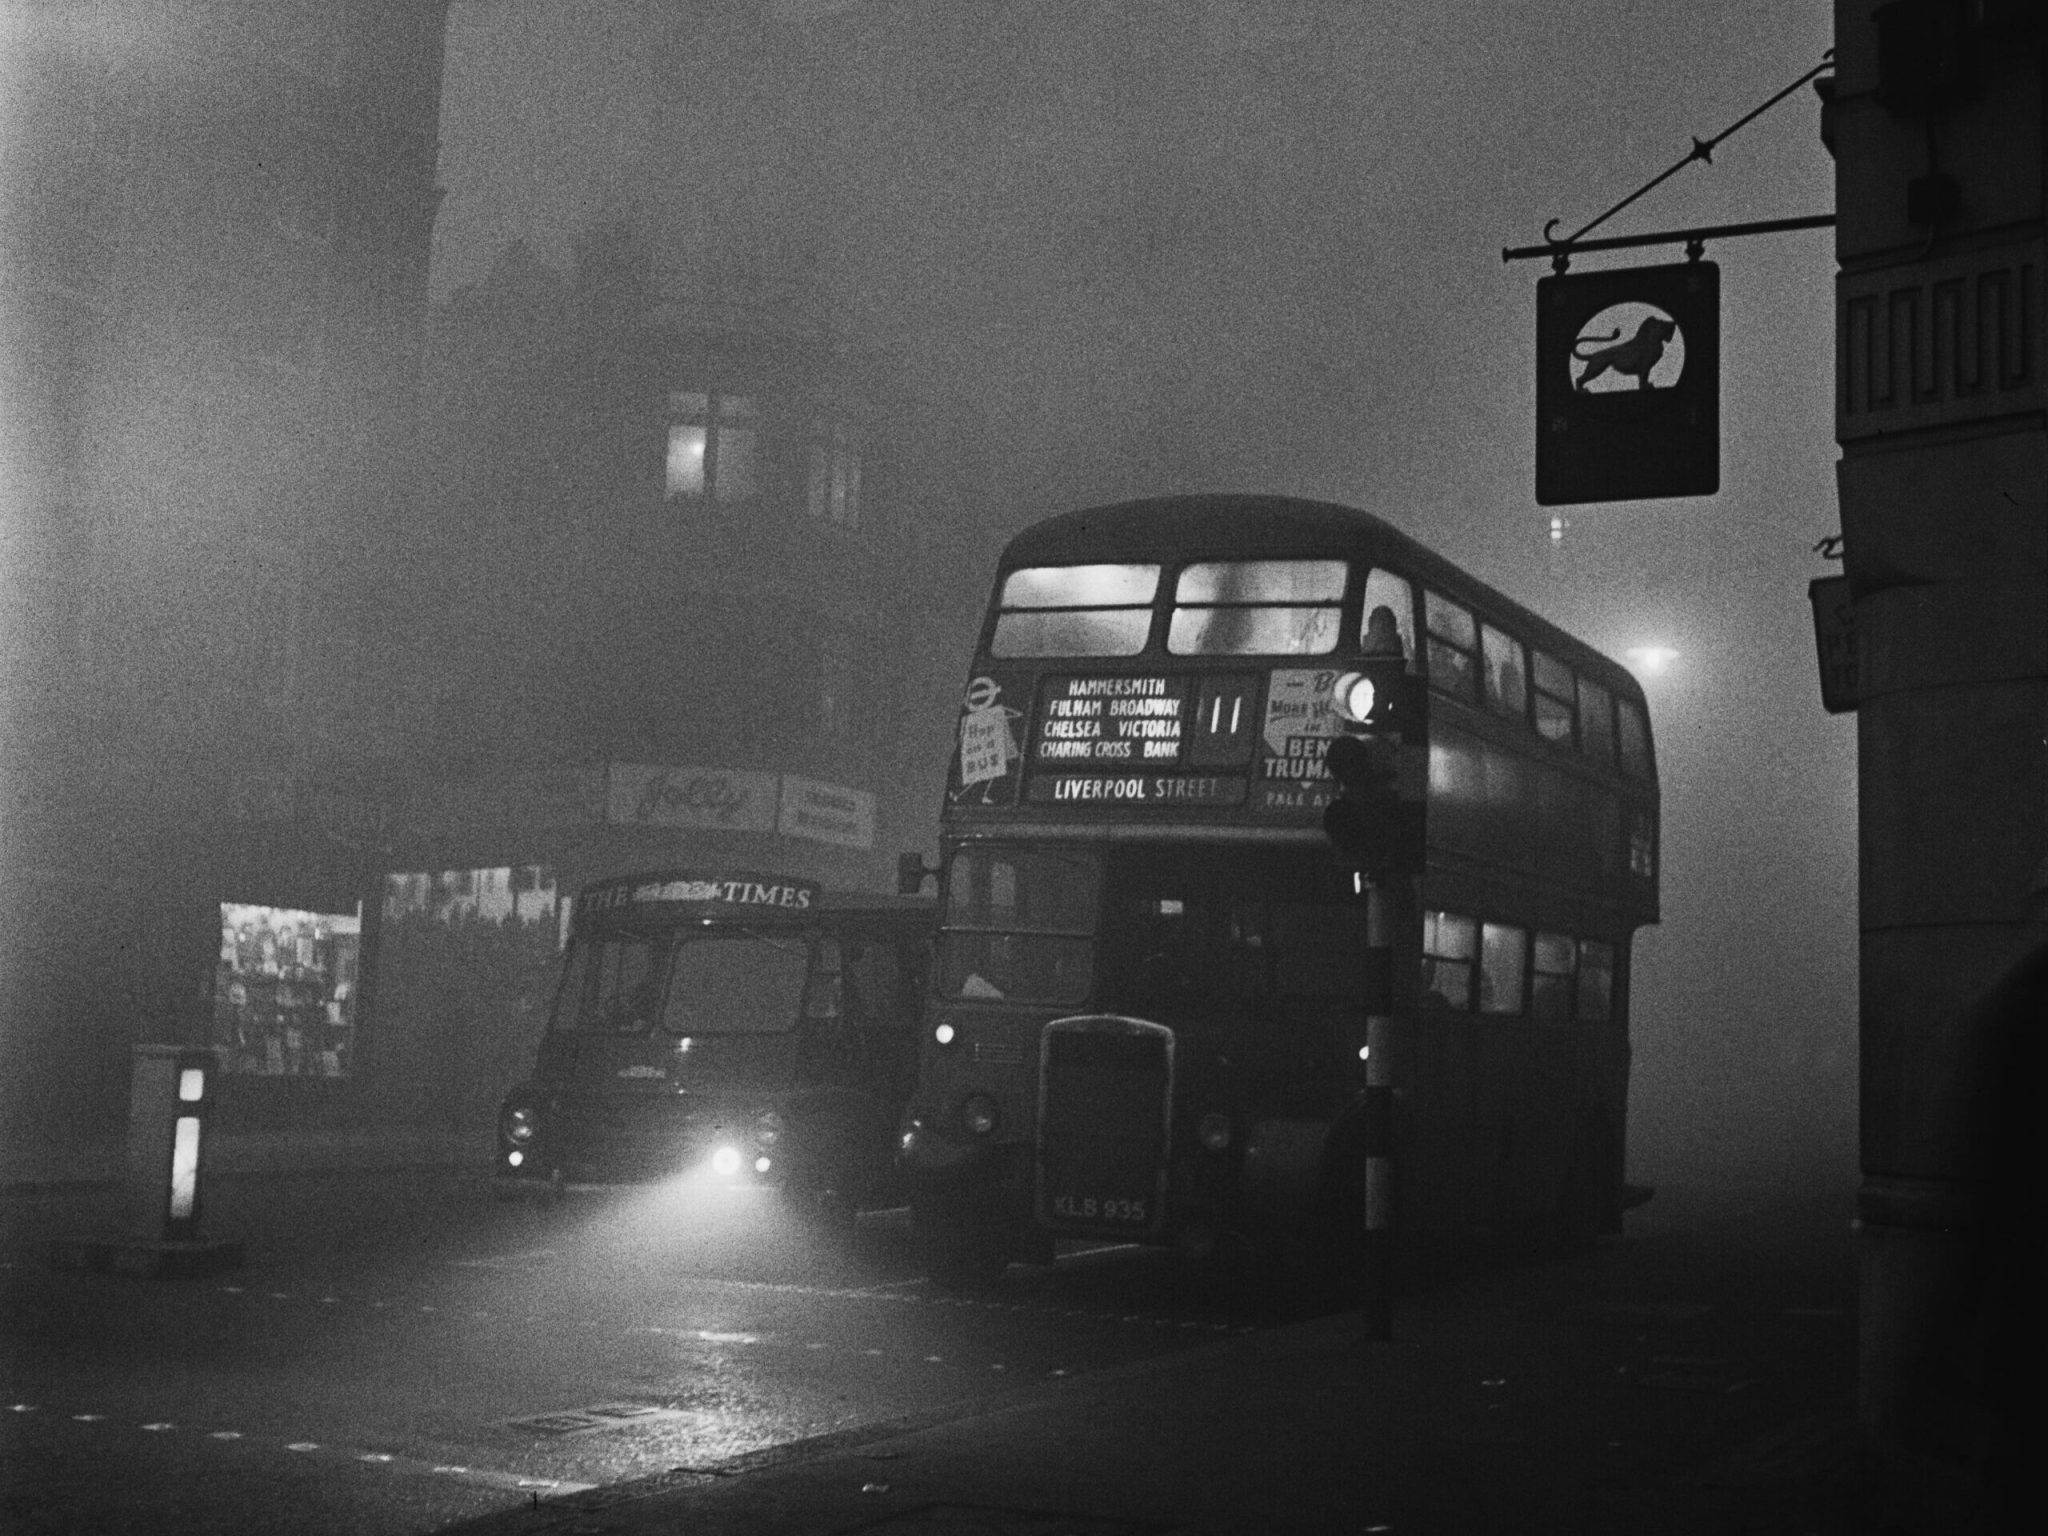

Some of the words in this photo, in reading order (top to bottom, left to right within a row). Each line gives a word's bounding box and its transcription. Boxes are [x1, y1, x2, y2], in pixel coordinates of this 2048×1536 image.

[1069, 678, 1165, 695] HAMMERSMITH
[1050, 700, 1101, 717] FULHAM
[1110, 699, 1180, 716] BROADWAY
[1210, 696, 1241, 734] 11
[1045, 721, 1100, 738] CHELSEA
[1119, 720, 1180, 737] VICTORIA
[1040, 741, 1092, 758] CHARING
[1095, 741, 1130, 757] CROSS
[1144, 741, 1180, 758] BANK
[1288, 739, 1332, 758] BEN
[1055, 779, 1145, 799] LIVERPOOL
[1155, 778, 1218, 798] STREET
[1266, 791, 1304, 806] PALE
[722, 880, 812, 909] TIMES
[1054, 1195, 1098, 1218] KLB
[1103, 1199, 1146, 1221] 935
